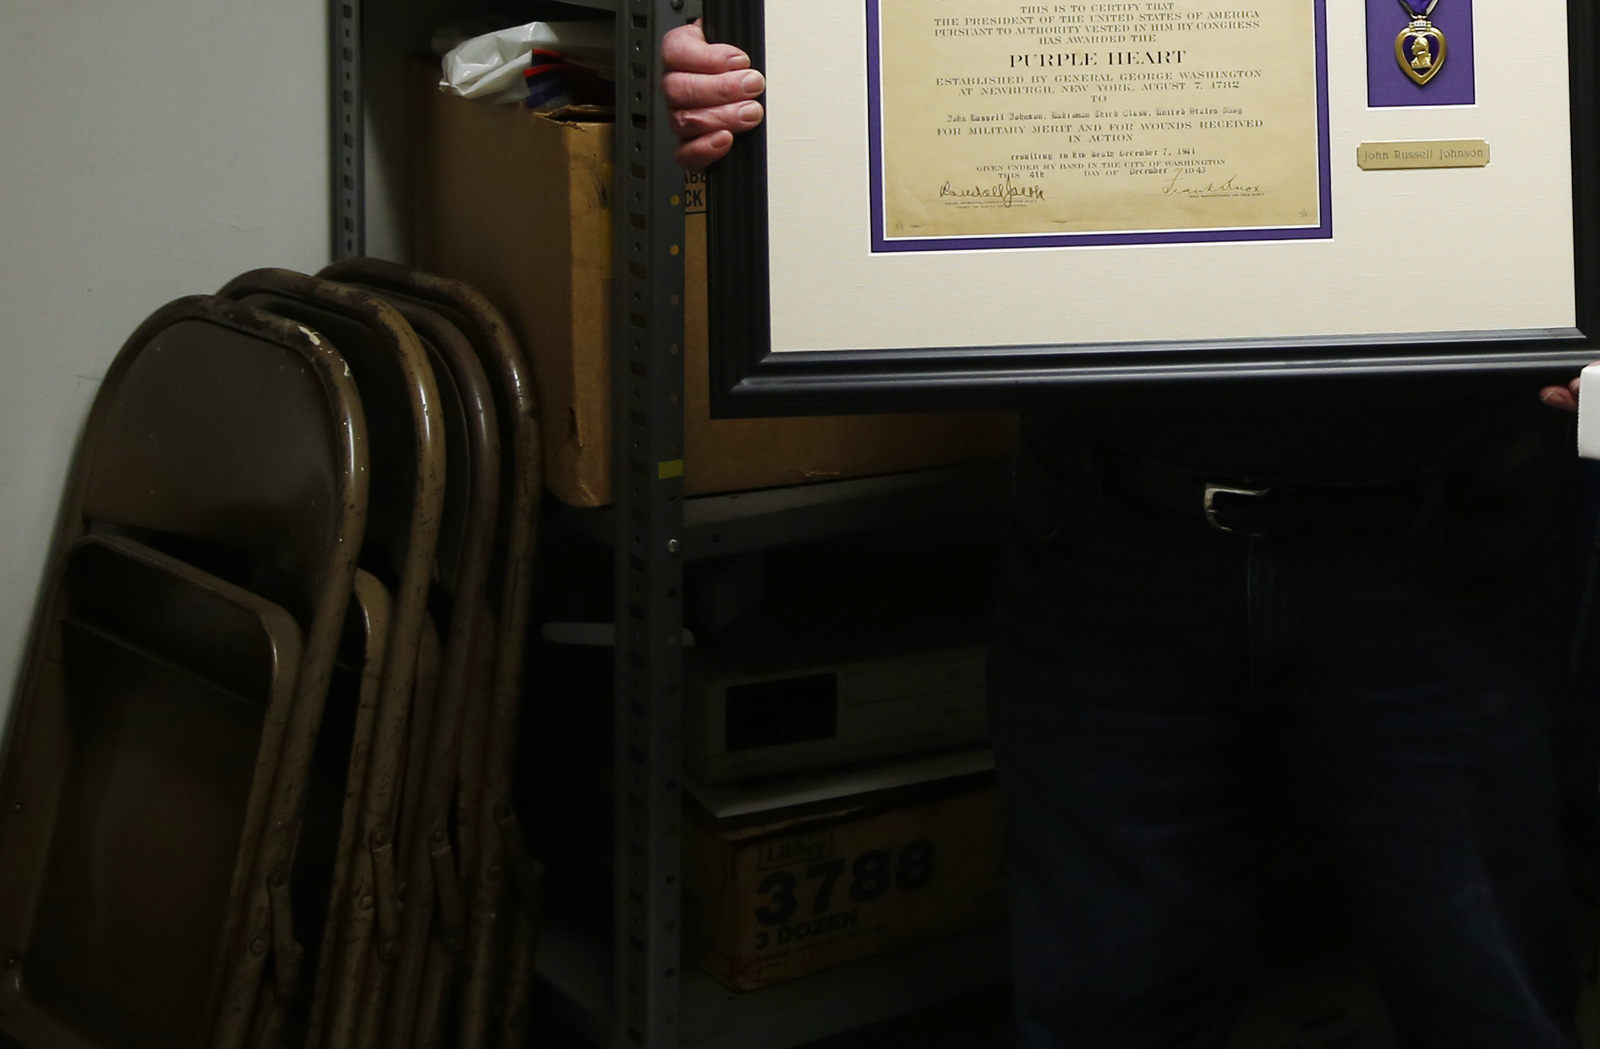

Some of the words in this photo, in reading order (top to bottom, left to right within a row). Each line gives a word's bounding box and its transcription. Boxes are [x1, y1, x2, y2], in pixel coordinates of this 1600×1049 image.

[1091, 3, 1141, 12] CERTIFY
[934, 18, 959, 26] THE
[965, 17, 1034, 25] PRESIDENT
[1060, 15, 1084, 23] THE
[1090, 14, 1134, 22] UNITED
[1139, 13, 1181, 21] STATES
[1207, 10, 1260, 19] AMERICA
[934, 28, 993, 37] PURSUANT
[1016, 26, 1081, 35] AUTHORITY
[1086, 25, 1130, 33] VESTED
[1151, 23, 1173, 31] HIM
[1178, 23, 1193, 31] BY
[1197, 21, 1260, 30] CONGRESS
[1039, 37, 1062, 45] HAS
[1066, 35, 1125, 44] AWARDED
[1131, 34, 1156, 42] THE
[1010, 53, 1097, 68] PURPLE
[1108, 50, 1186, 65] HEART
[936, 76, 1024, 86] ESTABLISHED
[1032, 75, 1047, 83] BY
[1055, 74, 1113, 83] GENERAL
[1120, 73, 1173, 81] GEORGE
[1180, 70, 1262, 79] WASHINGTON
[959, 88, 973, 96] AT
[1062, 85, 1088, 93] NEW
[1141, 82, 1185, 91] AUGUST
[937, 128, 961, 136] FOR
[969, 126, 1026, 135] MILITARY
[1032, 125, 1072, 133] MERIT
[1078, 124, 1102, 132] AND
[1141, 122, 1192, 130] WOUNDS
[1200, 119, 1263, 128] RECEIVED
[1069, 135, 1081, 143] IN
[1089, 134, 1133, 142] ACTION
[1364, 152, 1388, 162] John
[1394, 150, 1432, 159] Russell
[1439, 148, 1483, 160] Johnson
[977, 164, 1003, 172] GIVEN
[755, 838, 936, 927] 3788
[755, 931, 770, 951] 3
[777, 909, 859, 946] DOZEN
